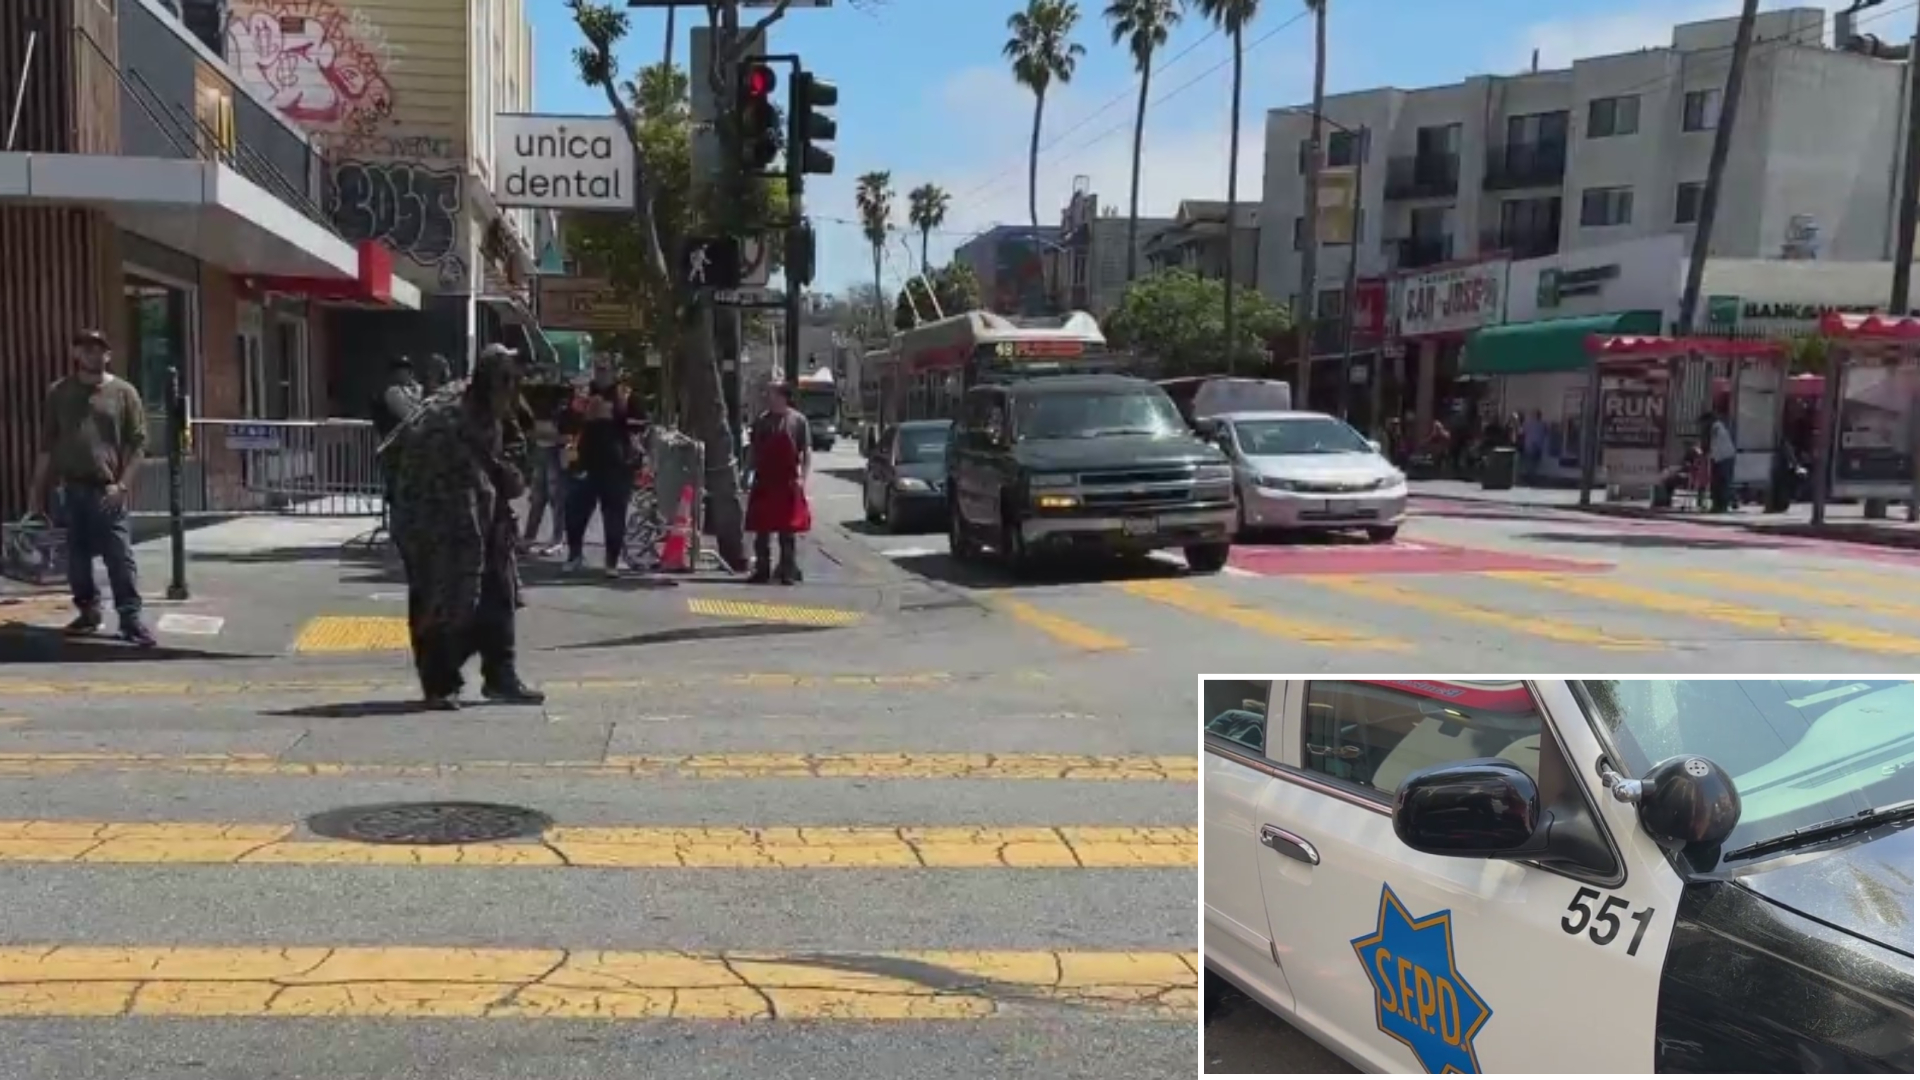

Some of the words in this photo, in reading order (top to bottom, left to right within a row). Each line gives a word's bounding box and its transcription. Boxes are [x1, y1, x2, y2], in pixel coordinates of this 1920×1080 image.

[515, 125, 612, 159] unica
[506, 165, 621, 199] dental
[1744, 302, 1801, 319] BANK
[1605, 396, 1664, 417] RUN
[1561, 886, 1655, 957] 551
